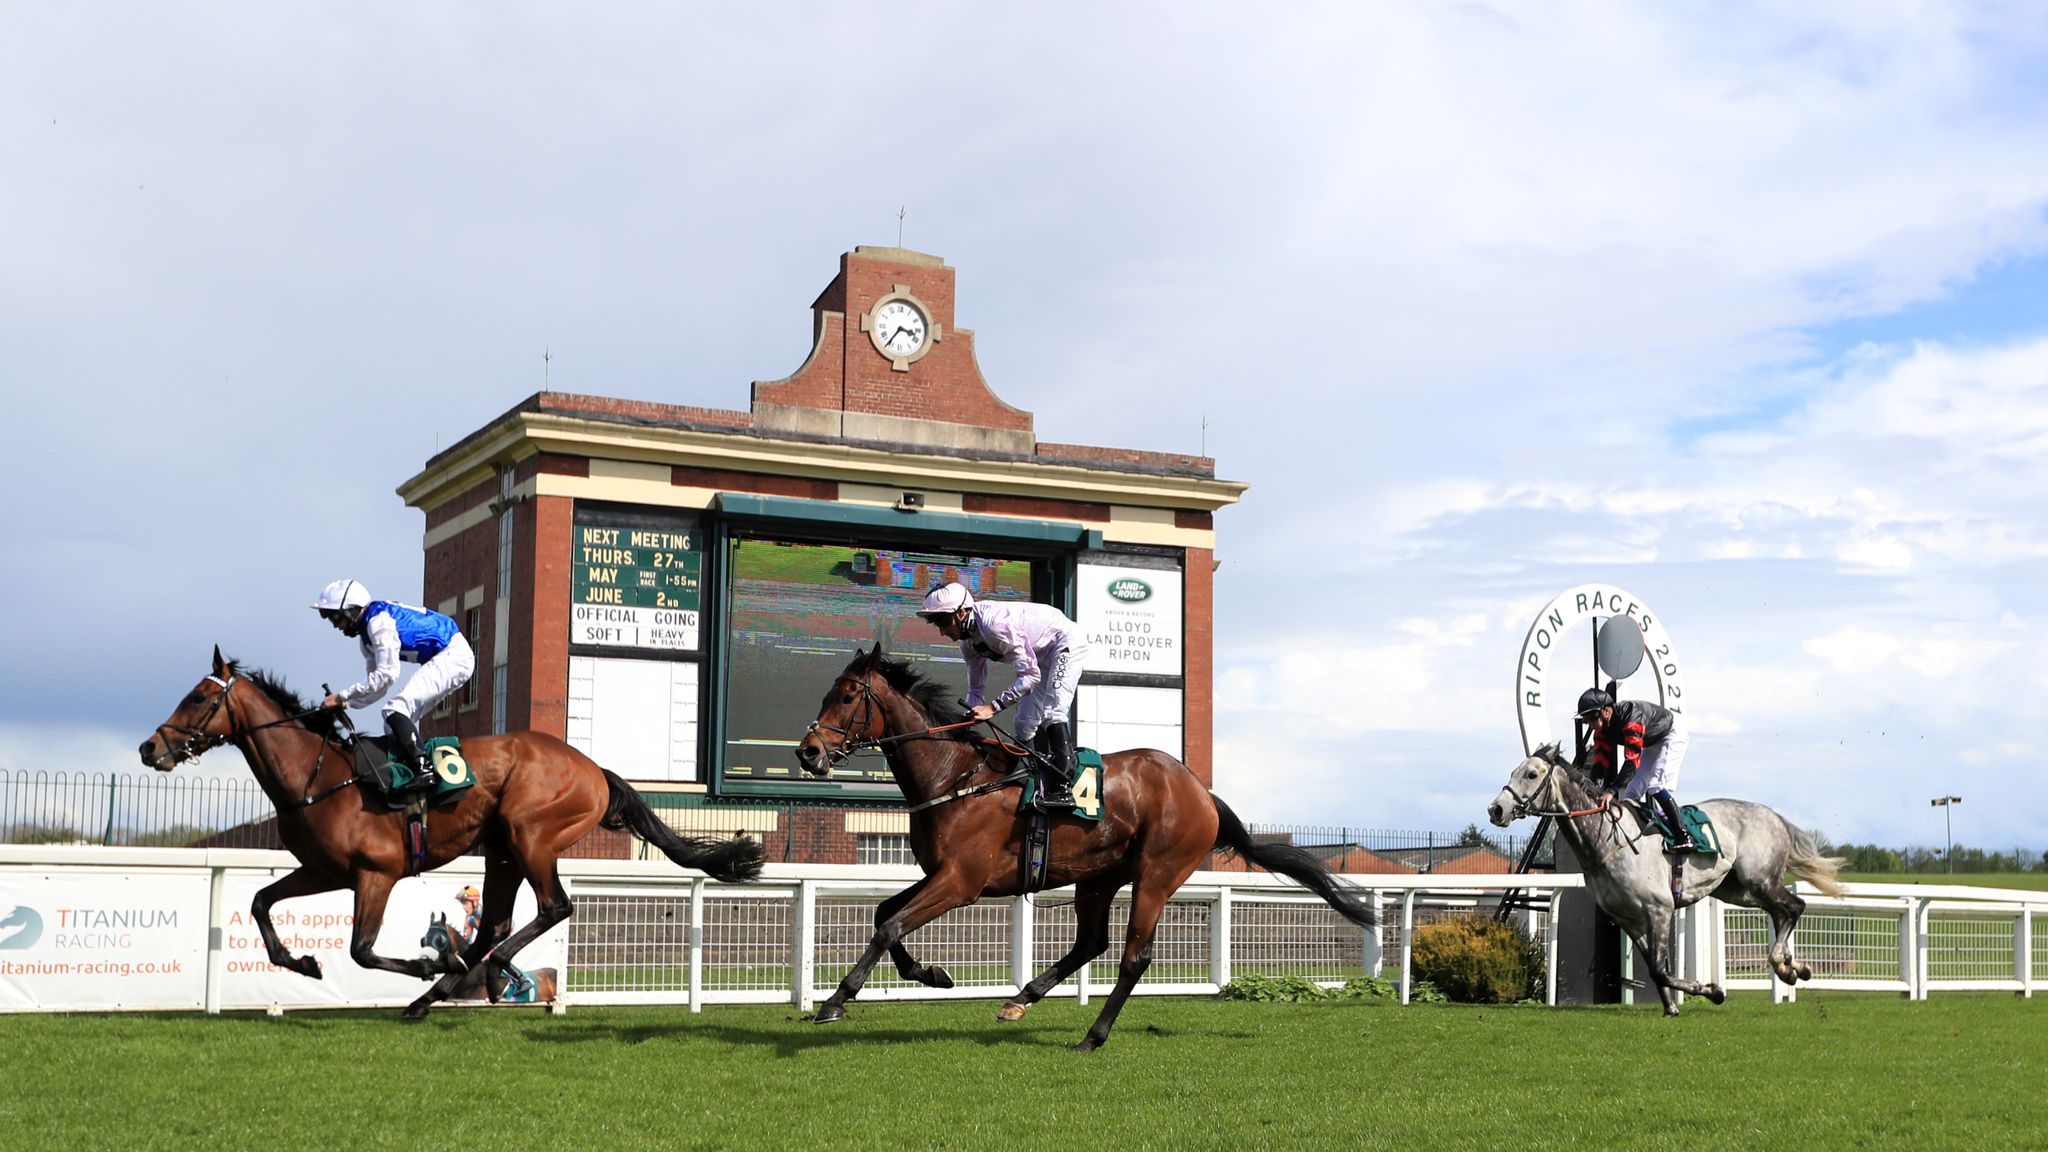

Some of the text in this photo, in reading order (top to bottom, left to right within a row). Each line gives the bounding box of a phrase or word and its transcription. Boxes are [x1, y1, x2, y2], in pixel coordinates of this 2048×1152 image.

[583, 528, 691, 550] NEXT MEETING
[583, 547, 636, 566] THURS.
[589, 567, 618, 584] MAY
[1115, 581, 1139, 590] LAND
[586, 587, 623, 604] JUNE
[1117, 590, 1146, 600] ROVER
[576, 607, 696, 627] OFFICIAL GOING
[586, 627, 622, 641] SOFT
[651, 628, 685, 640] HEAVY
[1109, 621, 1151, 634] LLOYD
[1086, 633, 1173, 649] LAND ROVER
[1109, 648, 1150, 661] RIPON
[1525, 590, 1683, 715] RIPON RACES 2021
[1052, 653, 1068, 690] Clipper
[433, 745, 467, 785] 6
[1072, 766, 1100, 816] 4
[1701, 823, 1717, 851] 1
[56, 909, 178, 929] TITANIUM
[229, 910, 243, 926] A
[301, 913, 385, 929] appro
[55, 933, 132, 949] RACING
[229, 933, 344, 949] to rehorse
[0, 959, 182, 977] itanium-racing.co.uk
